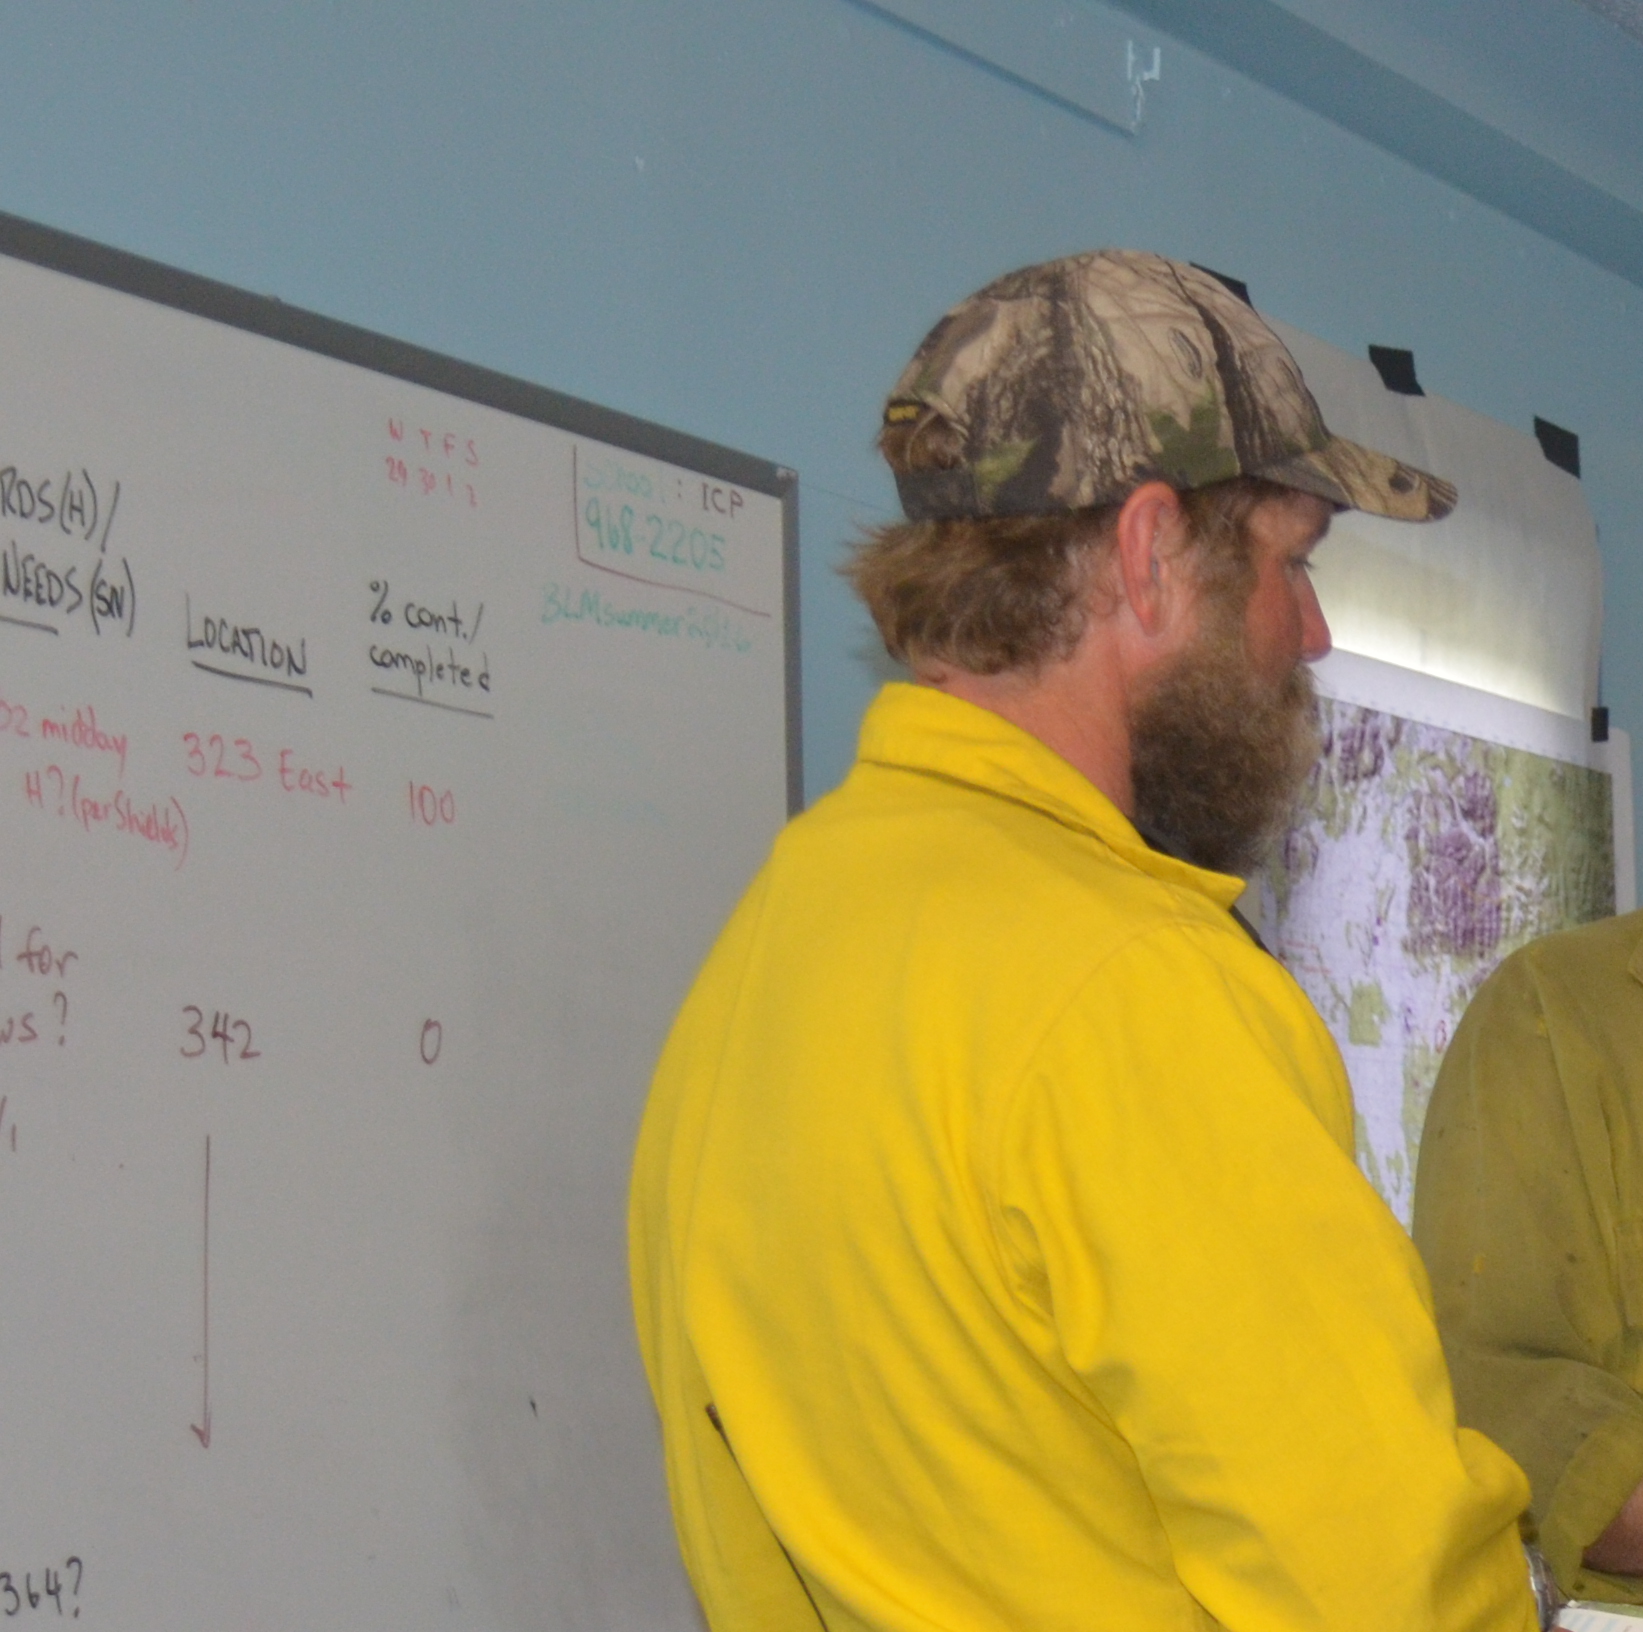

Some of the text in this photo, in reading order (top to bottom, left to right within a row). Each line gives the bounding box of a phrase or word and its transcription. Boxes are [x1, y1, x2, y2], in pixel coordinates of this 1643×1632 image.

[701, 481, 746, 519] ICP
[185, 591, 307, 677] LOCATION
[369, 643, 492, 699] completed
[41, 703, 129, 779] midday
[183, 731, 263, 782] 323
[278, 748, 354, 805] East
[408, 779, 457, 827] 100
[15, 924, 80, 977] for
[179, 1003, 262, 1064] 342
